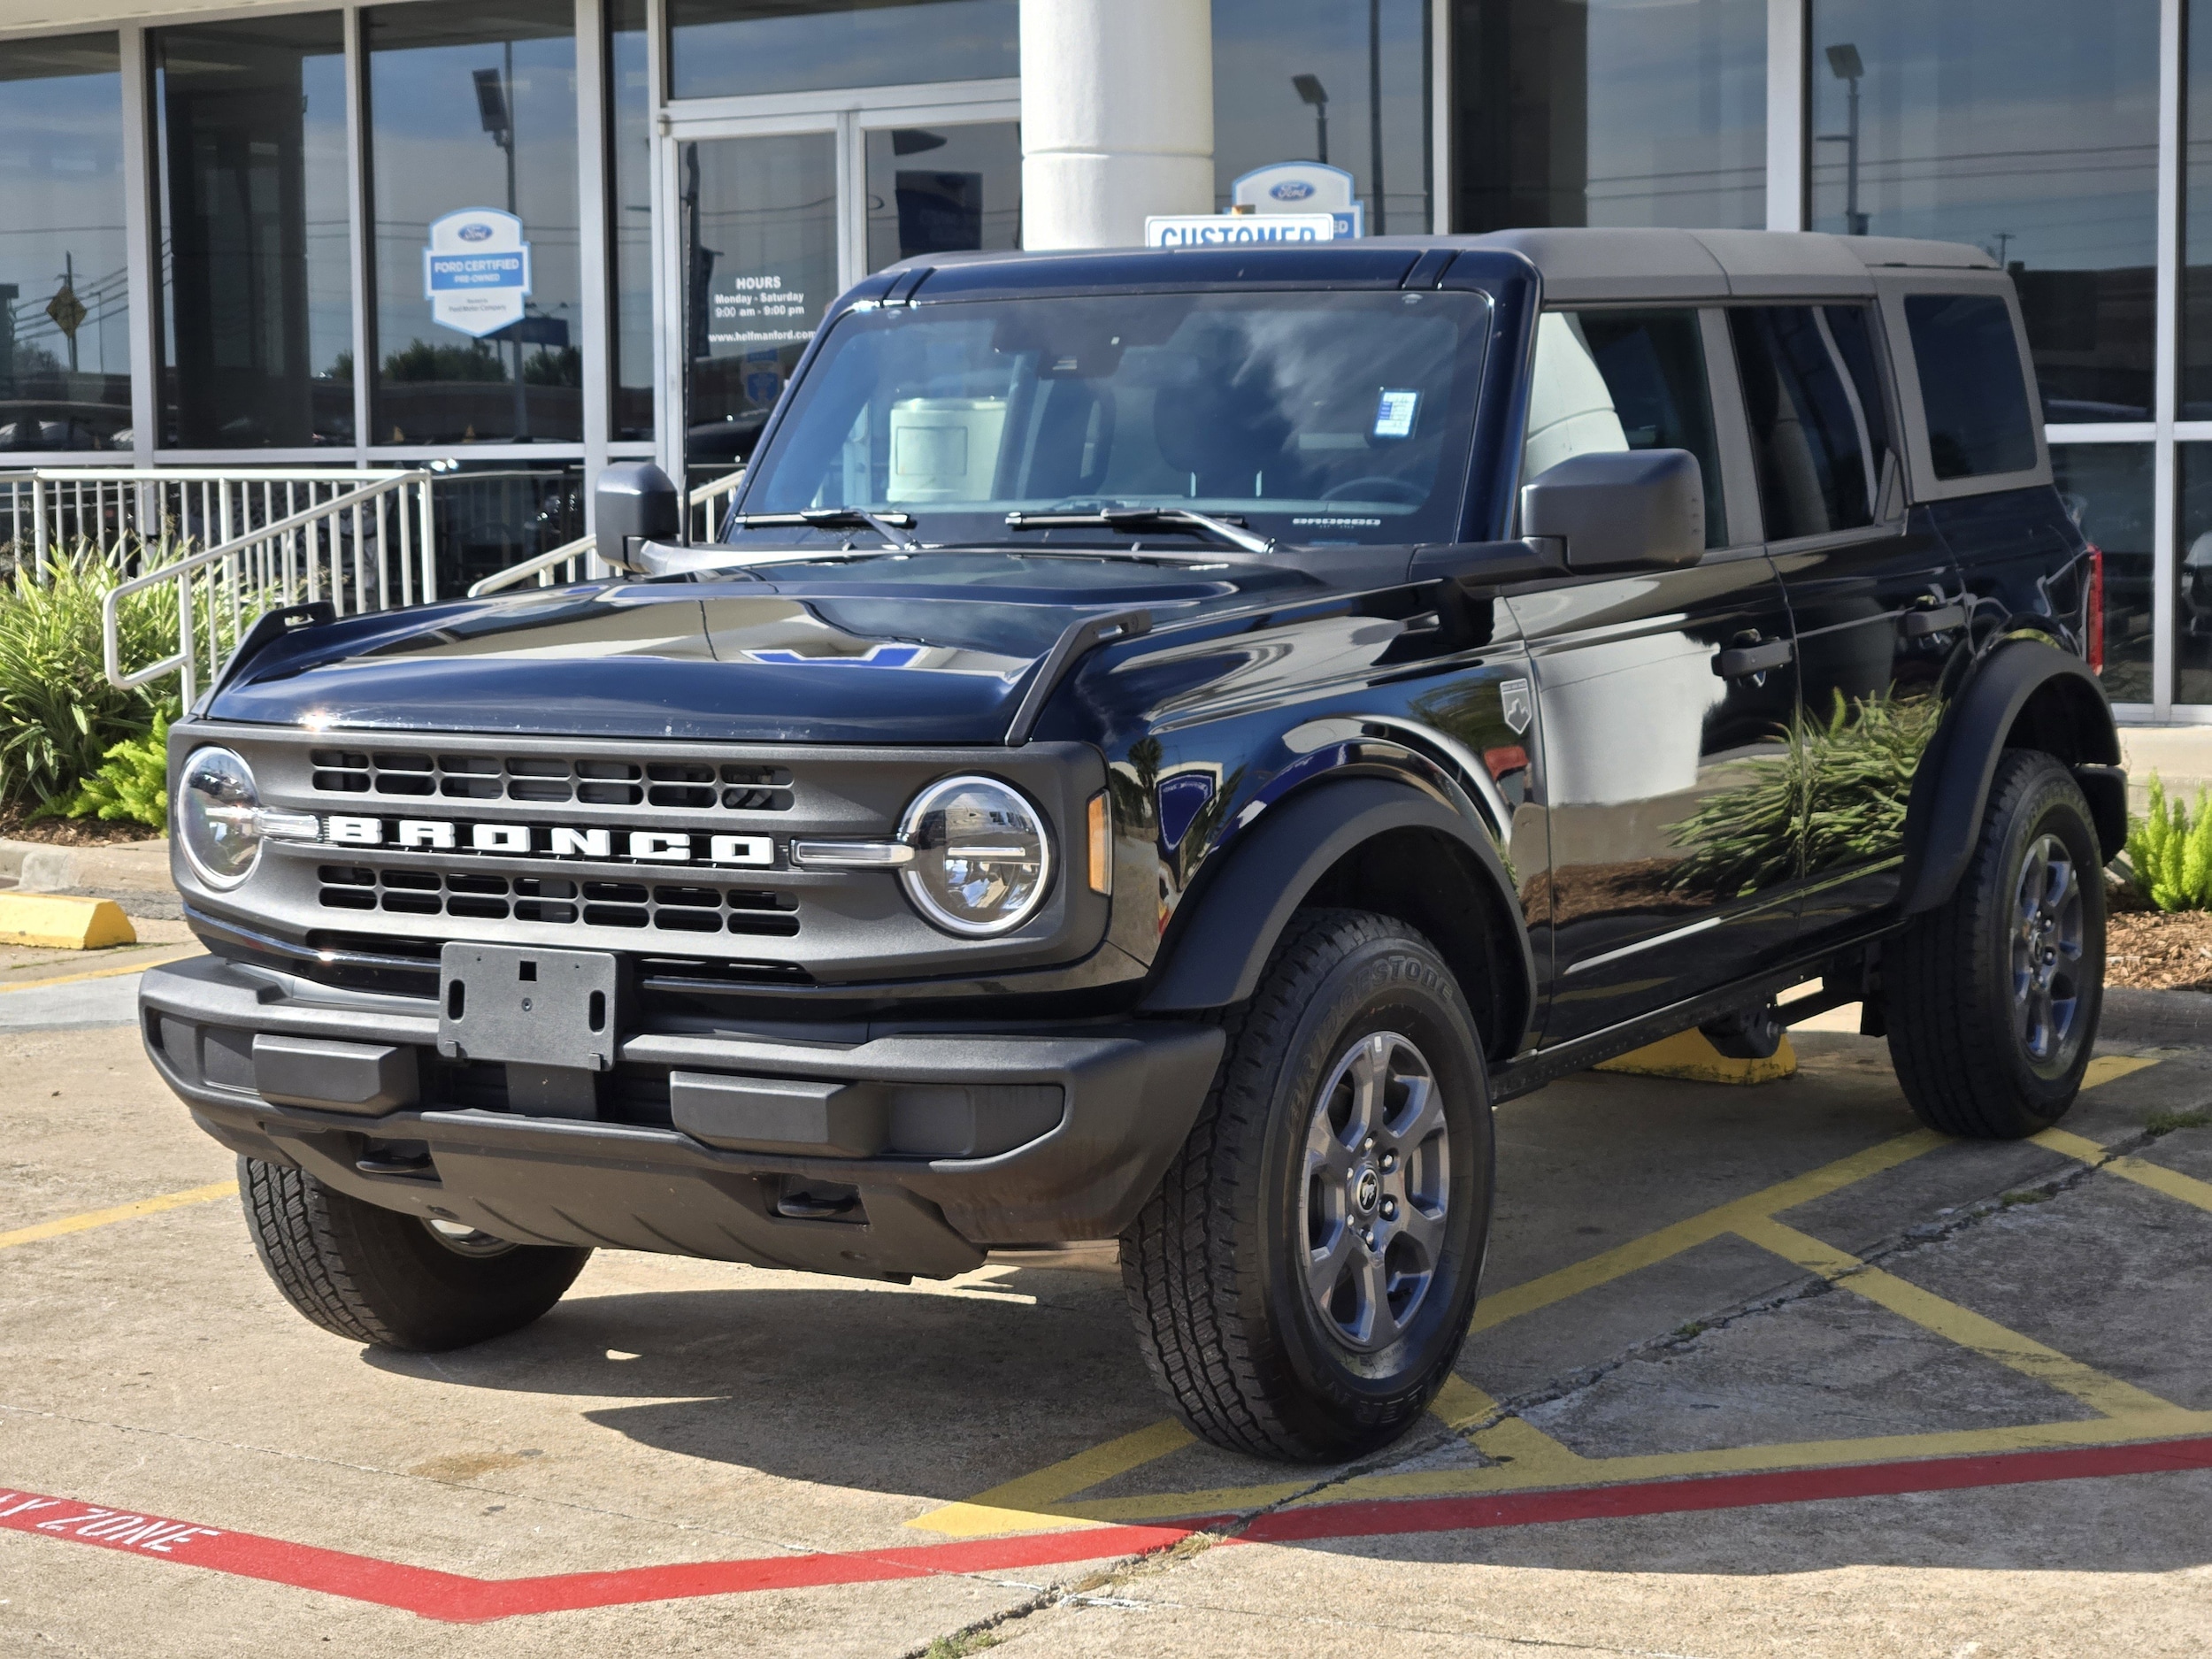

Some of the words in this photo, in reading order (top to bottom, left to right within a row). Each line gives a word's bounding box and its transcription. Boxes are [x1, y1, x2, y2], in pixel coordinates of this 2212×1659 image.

[434, 261, 464, 273] FORD
[465, 258, 519, 272] CERTIFIED
[454, 273, 500, 283] PRE-OWNED
[735, 276, 781, 289] HOURS
[715, 294, 752, 305] Monday
[760, 292, 804, 303] Saturday
[715, 307, 736, 318] 9:00
[740, 308, 756, 317] am
[763, 305, 786, 316] 9:00
[788, 306, 805, 317] pm
[328, 815, 774, 864] BRONCO
[36, 1508, 220, 1552] ZONE
